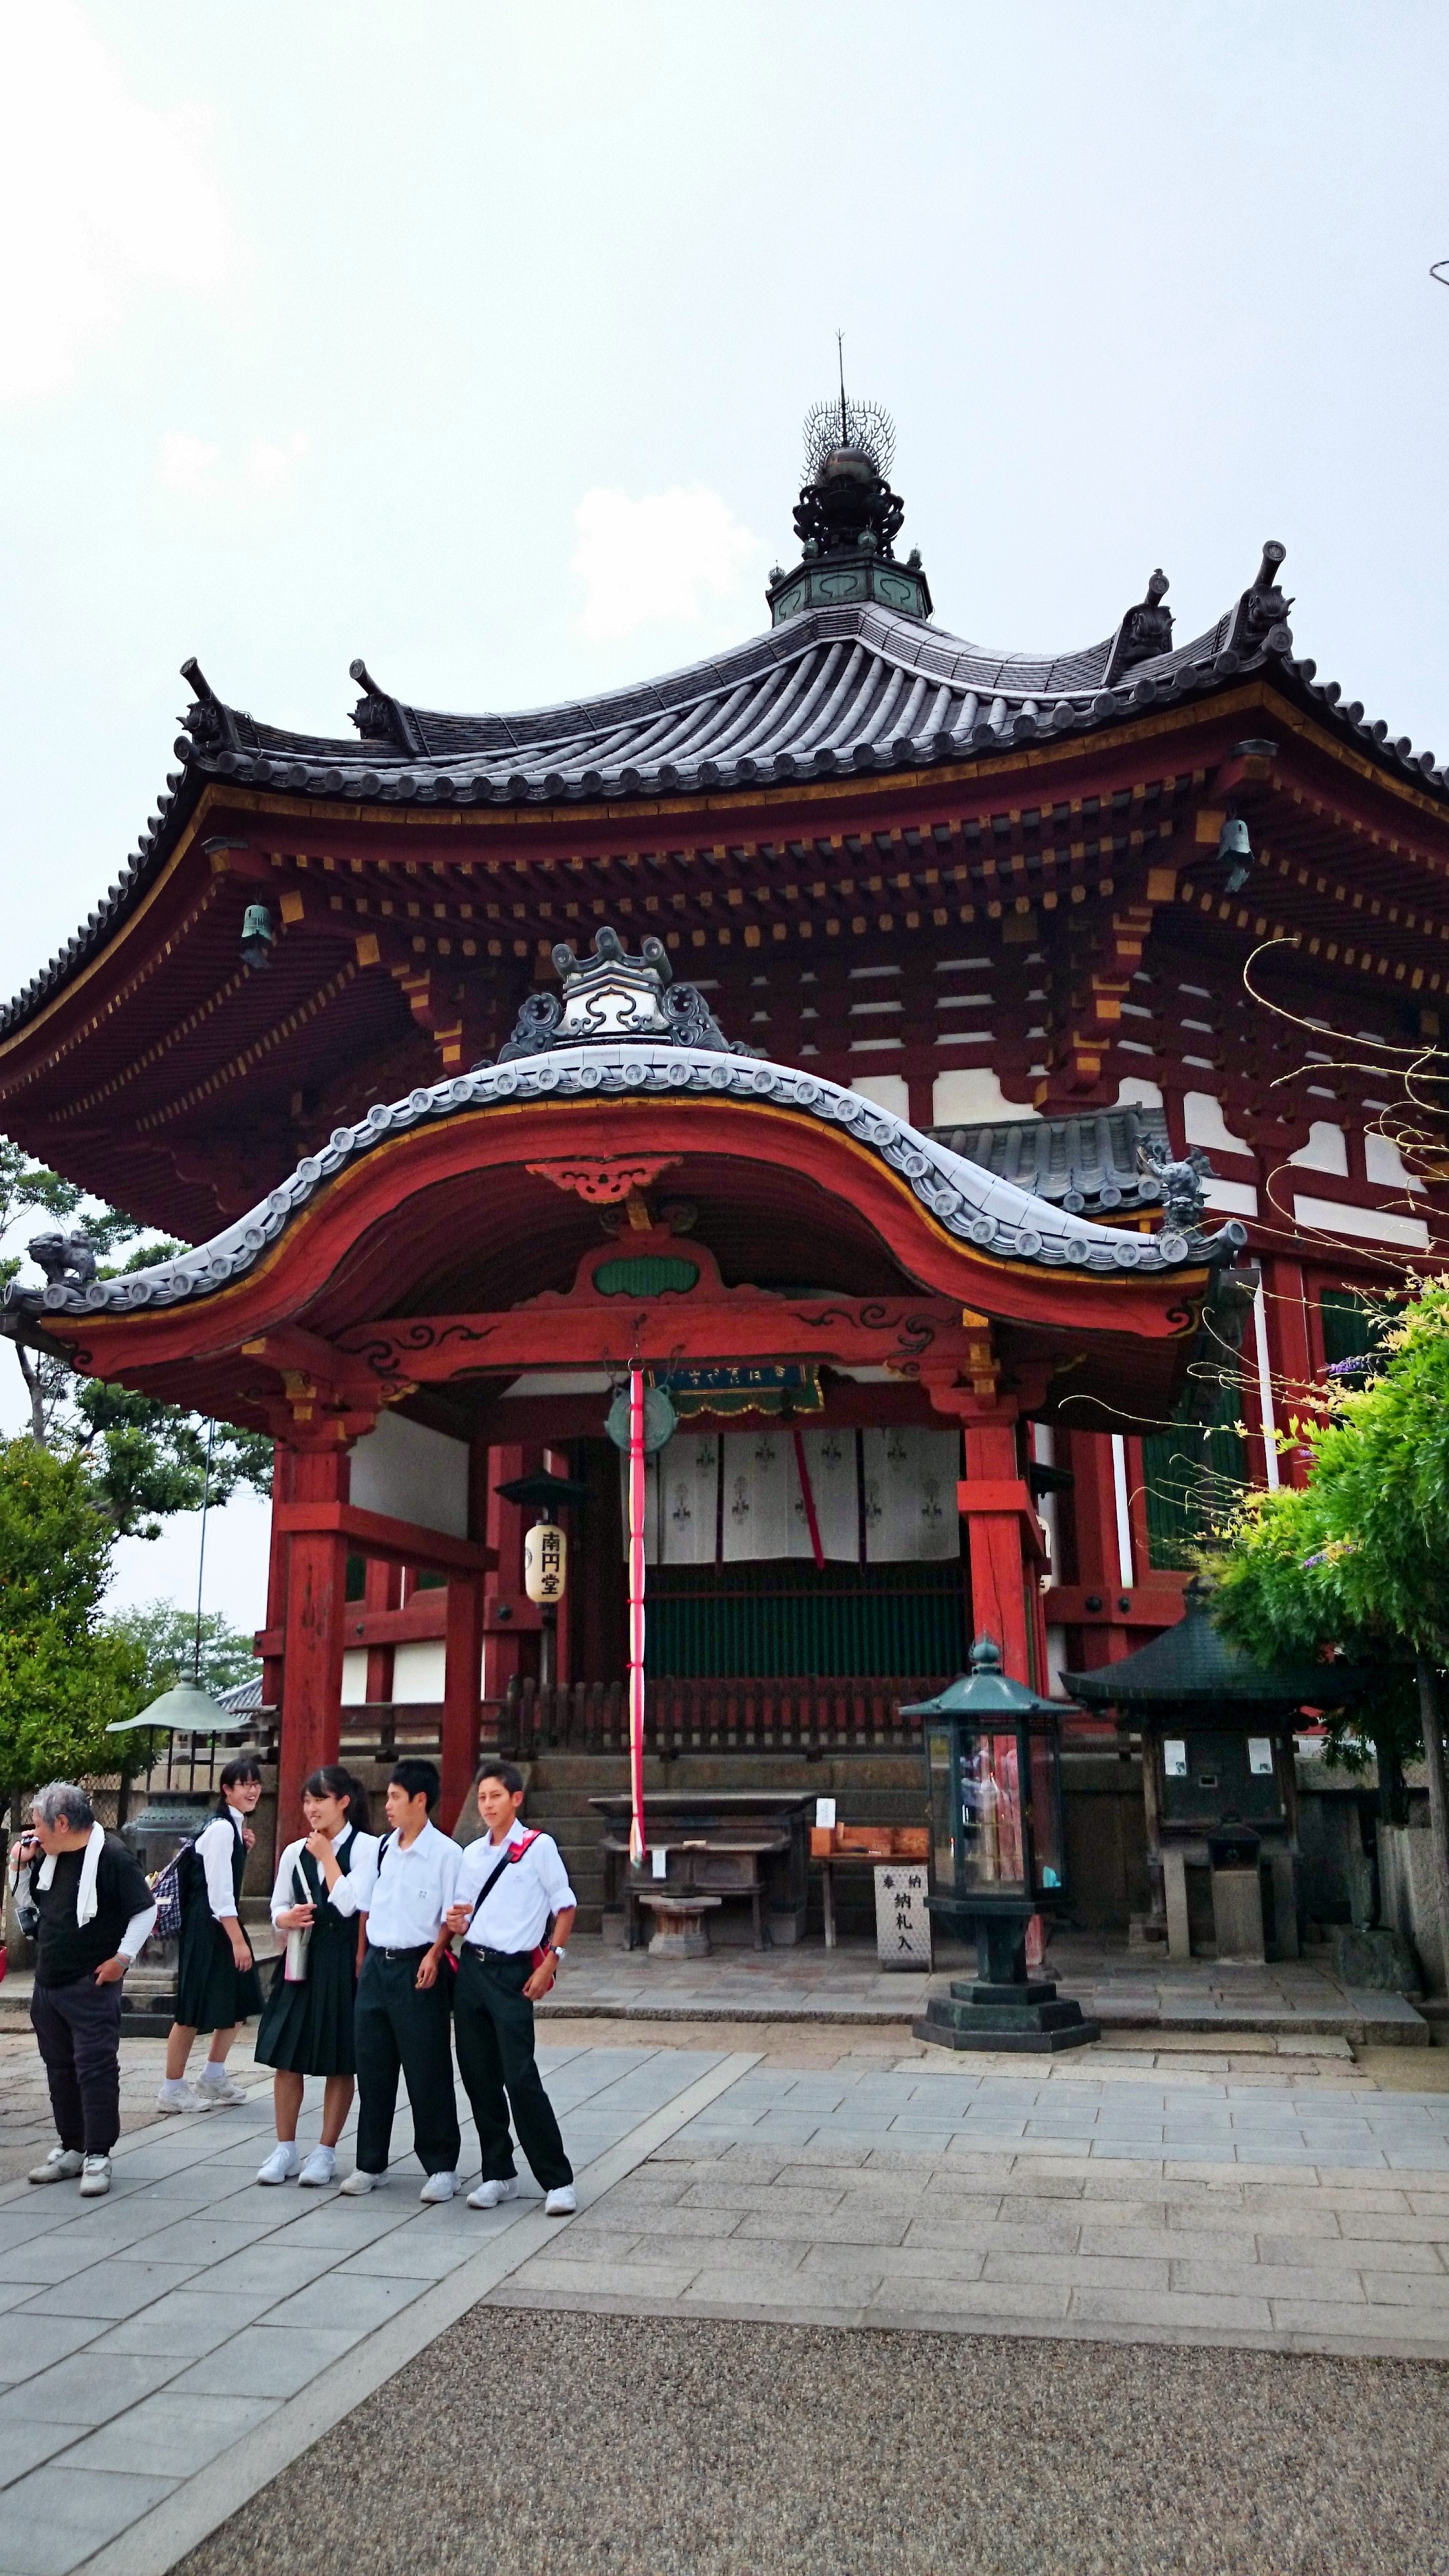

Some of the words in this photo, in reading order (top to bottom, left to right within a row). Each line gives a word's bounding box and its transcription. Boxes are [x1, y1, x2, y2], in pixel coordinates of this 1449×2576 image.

[541, 1531, 559, 1594] 南円堂
[894, 1892, 912, 1951] 納札入
